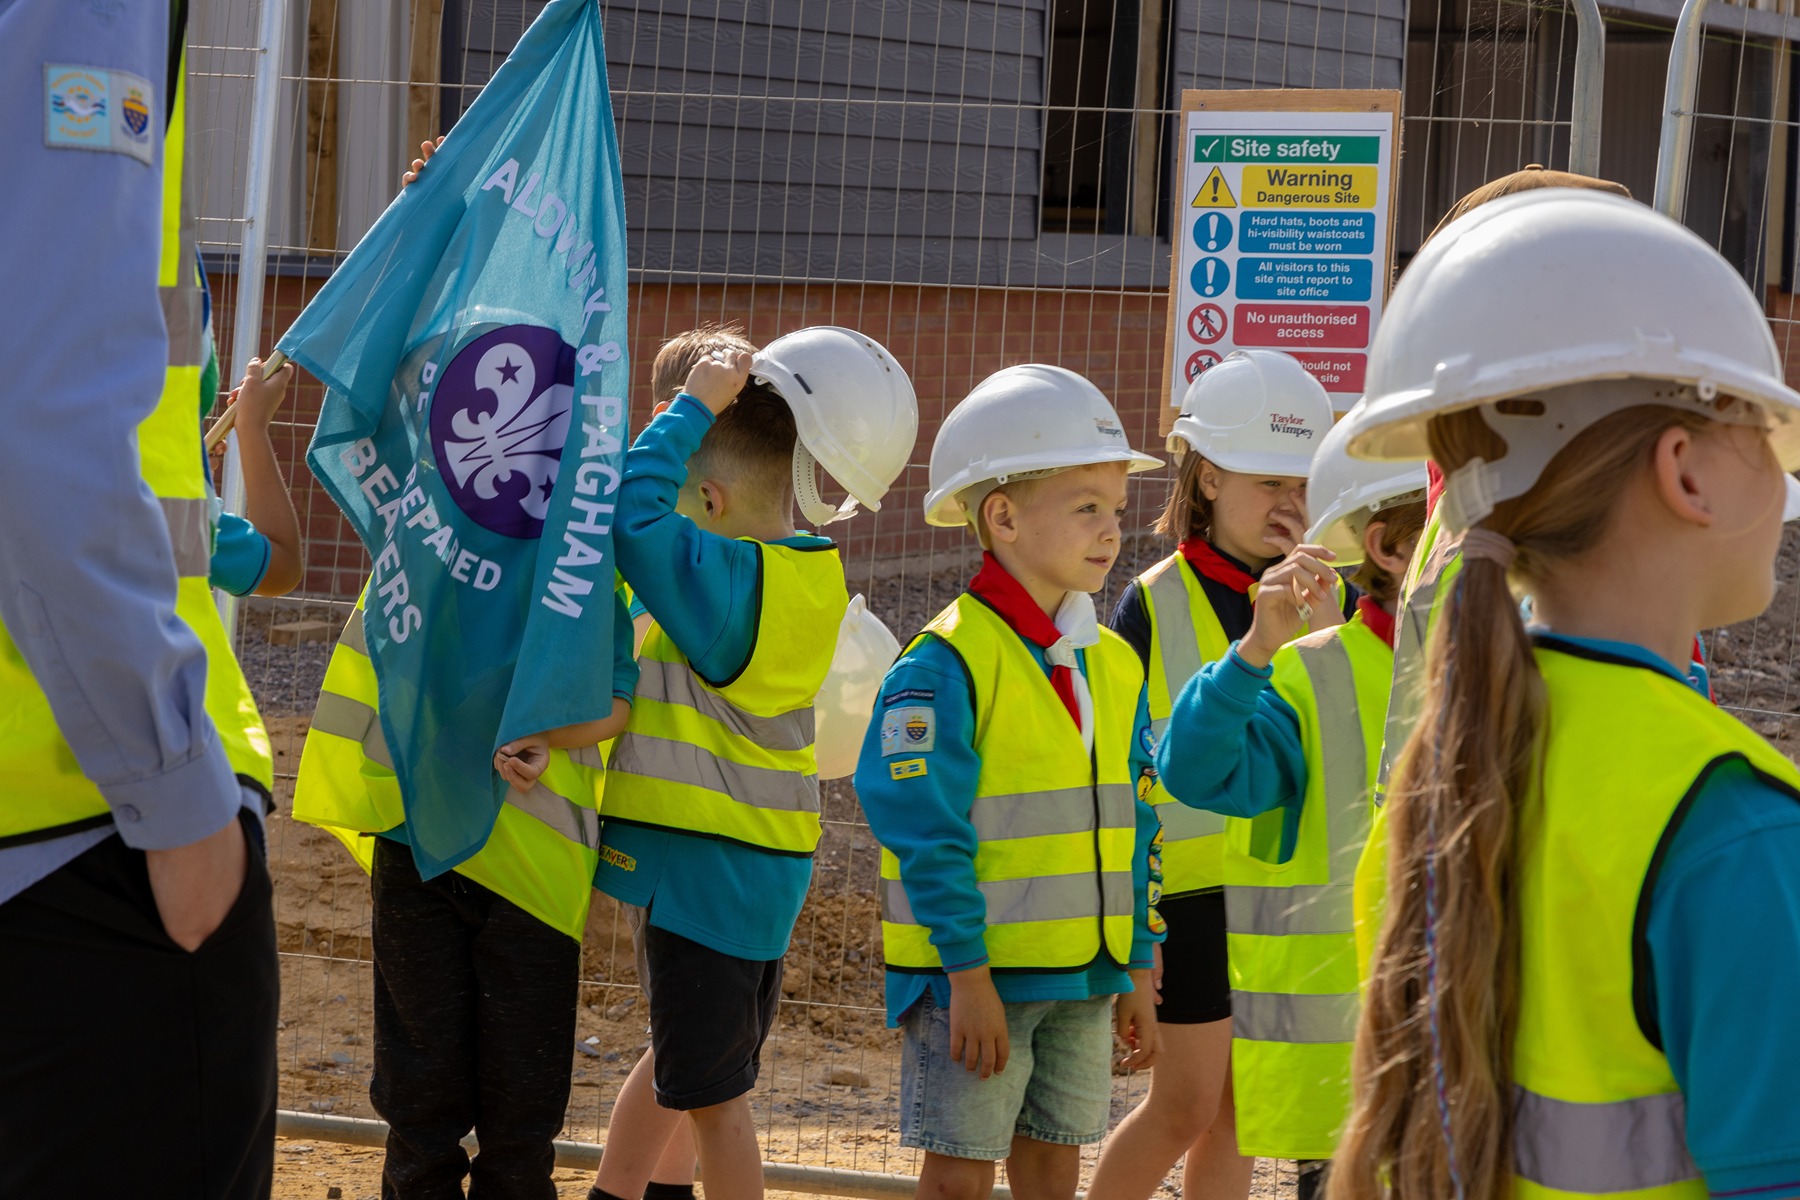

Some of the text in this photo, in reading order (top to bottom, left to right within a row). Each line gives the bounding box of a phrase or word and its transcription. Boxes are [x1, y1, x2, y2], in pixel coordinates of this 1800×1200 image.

[1230, 138, 1342, 162] Site safety
[1267, 169, 1353, 191] Warning
[1256, 191, 1360, 206] Dangerous Site
[1251, 216, 1363, 228] Hard hats, boots and
[1247, 228, 1366, 241] hi-visibility waistcoats
[1268, 241, 1343, 251] must be worn
[1258, 261, 1351, 273] All visitors to this
[1254, 274, 1353, 287] site must report to
[1276, 286, 1329, 297] site office
[1246, 312, 1358, 326] No unauthorised
[1277, 328, 1325, 339] access
[576, 340, 622, 377] &
[1300, 360, 1351, 371] hould not
[1320, 373, 1340, 383] site
[1270, 413, 1305, 425] Taylor
[1096, 425, 1123, 438] Wimpey
[1270, 423, 1315, 439] Wimpey
[541, 395, 623, 619] PAGHAM
[339, 436, 423, 644] BEAERS
[600, 845, 636, 870] EAVERS
